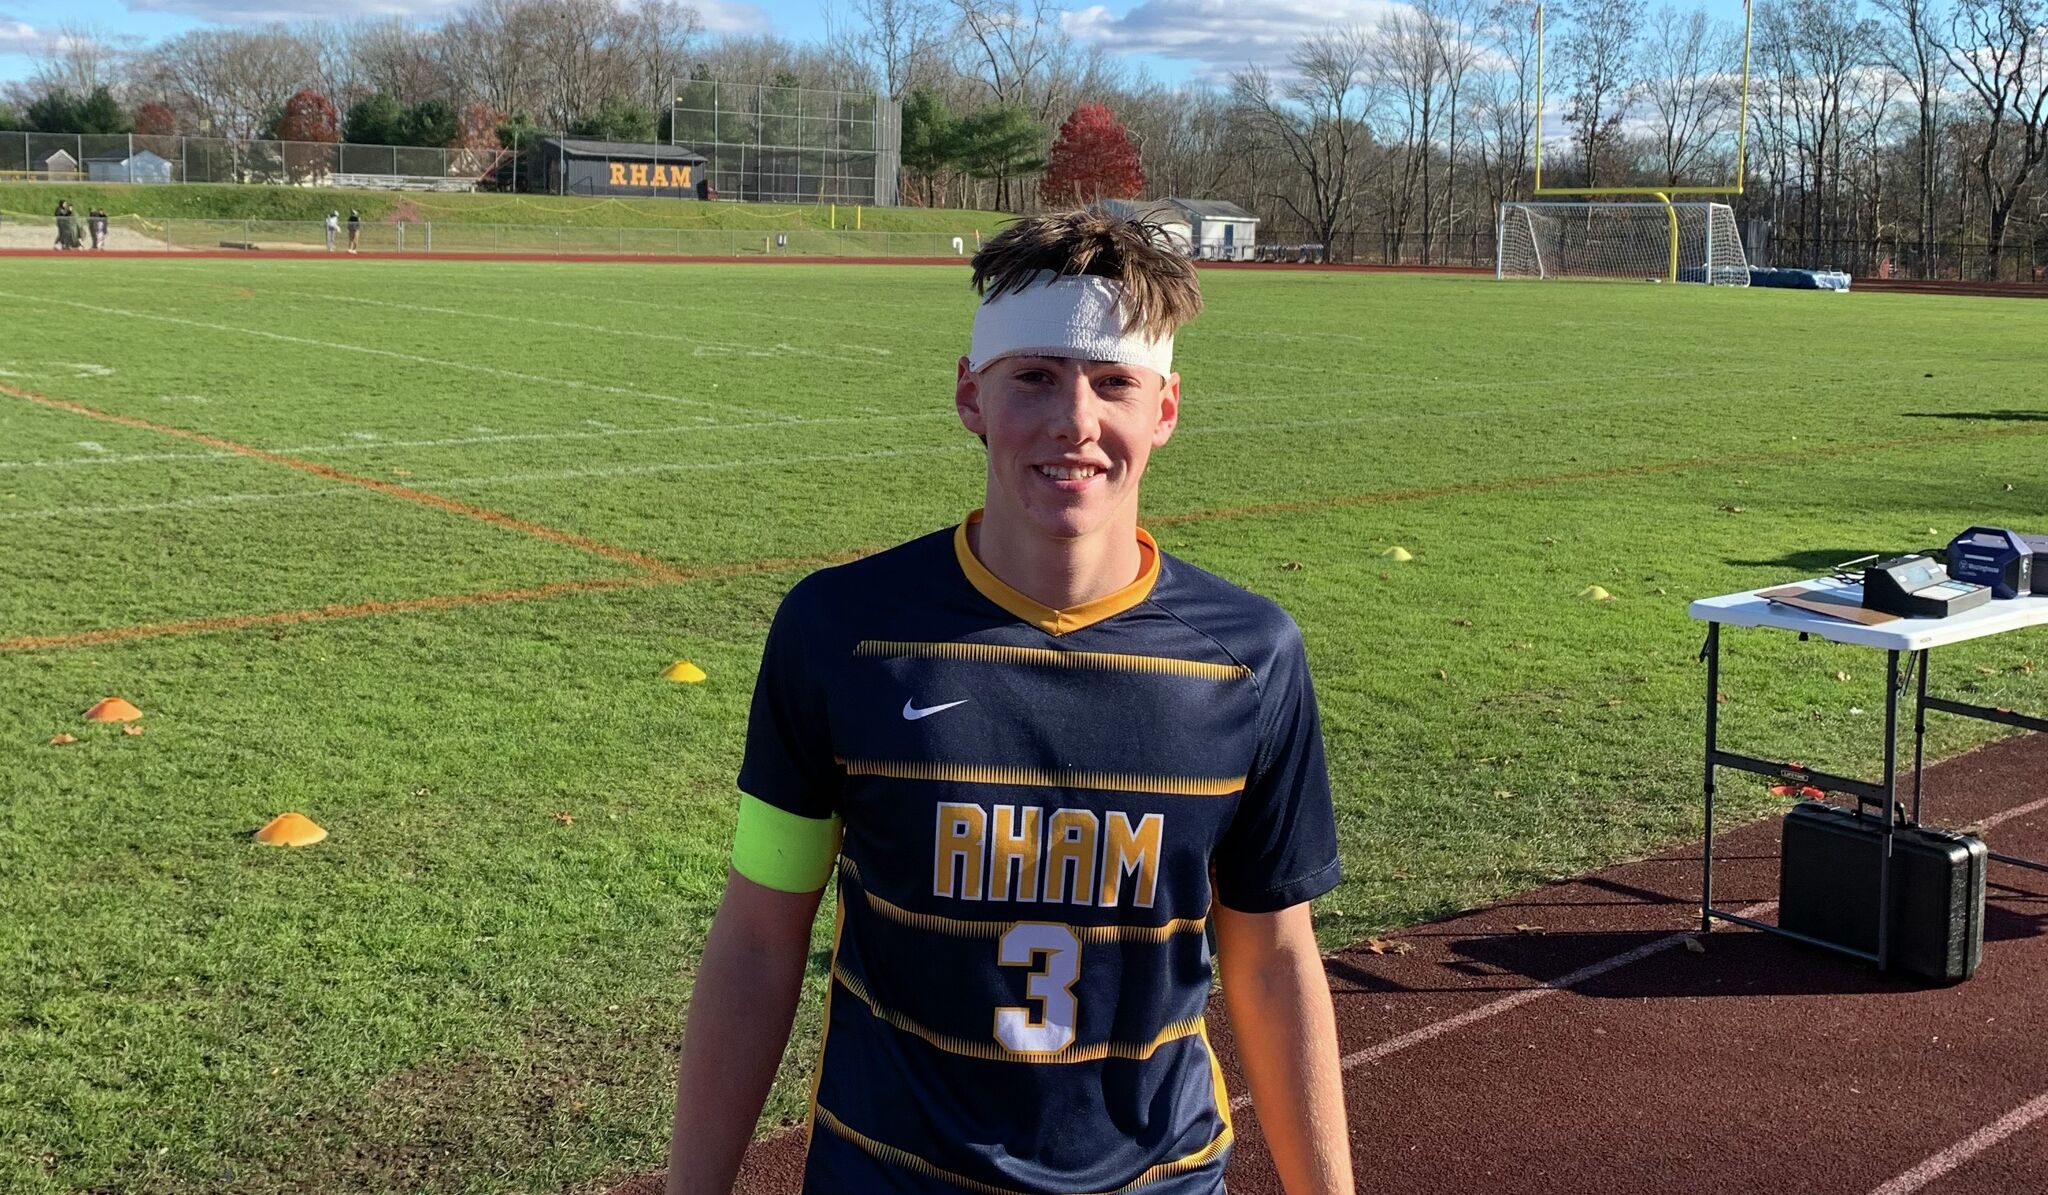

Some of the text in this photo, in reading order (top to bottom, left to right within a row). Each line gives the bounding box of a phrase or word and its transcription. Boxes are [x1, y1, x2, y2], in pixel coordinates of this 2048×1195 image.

[609, 162, 692, 188] RHAM
[934, 801, 1164, 908] RHAM
[993, 920, 1082, 1055] 3
